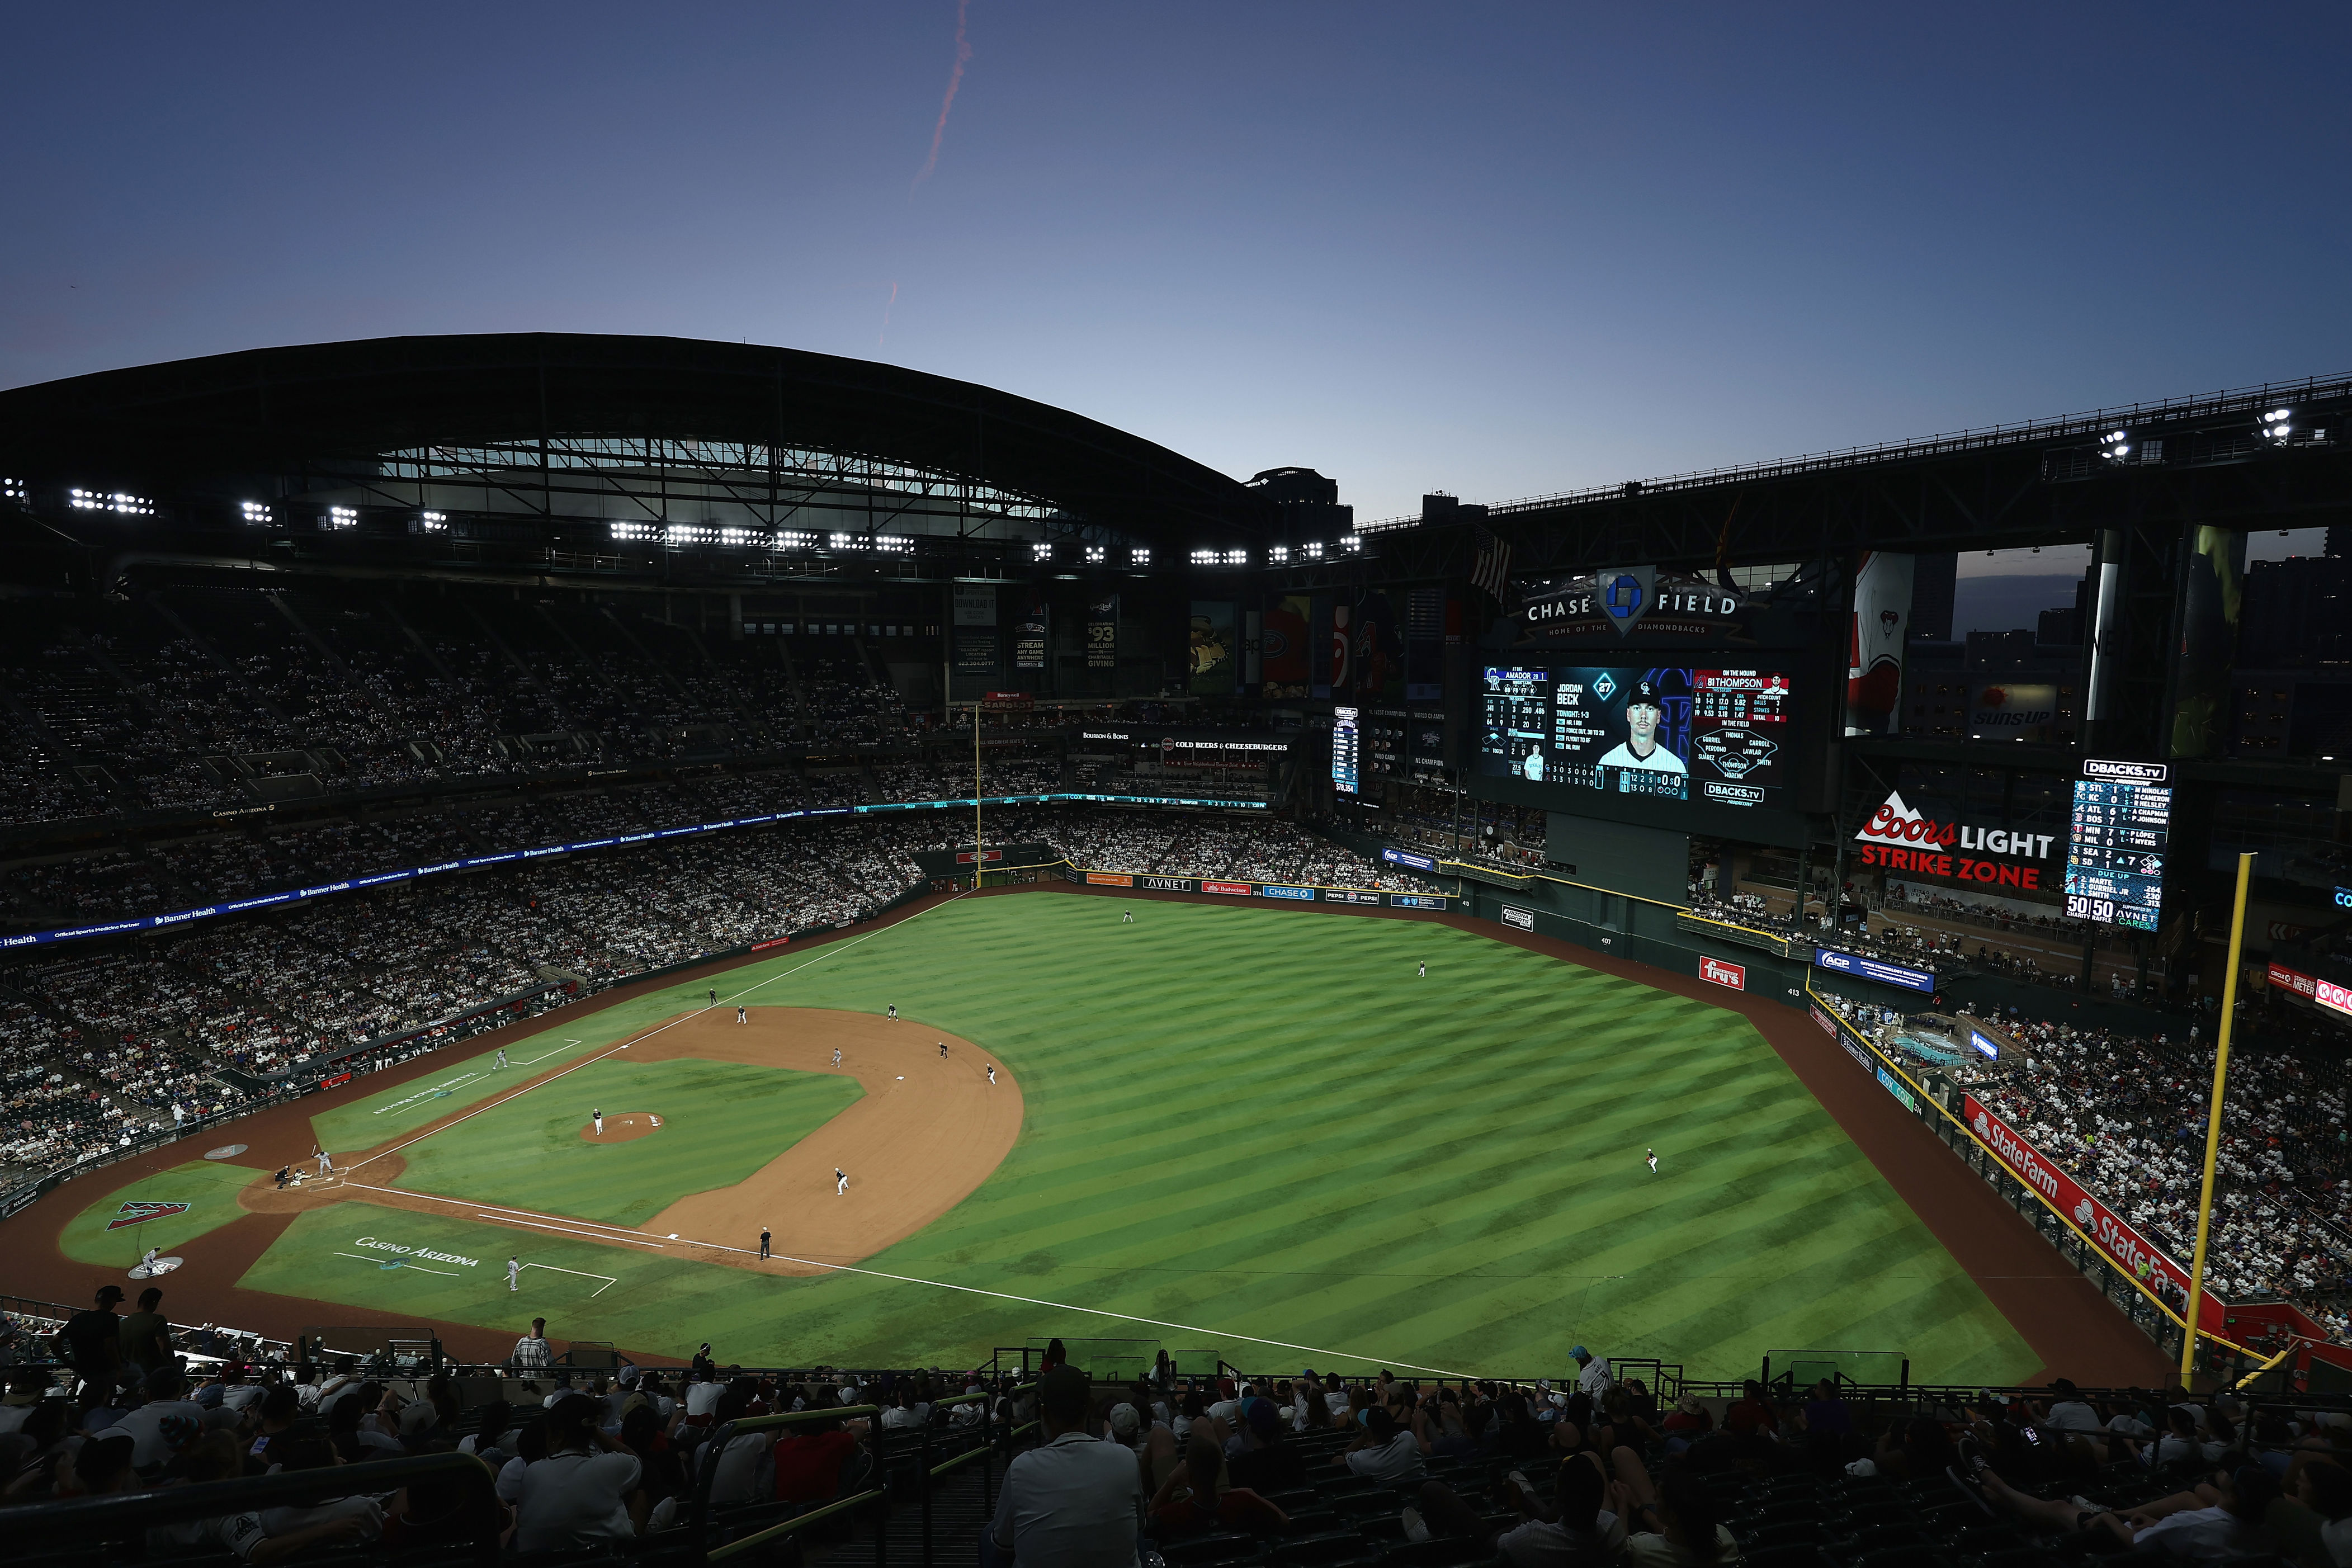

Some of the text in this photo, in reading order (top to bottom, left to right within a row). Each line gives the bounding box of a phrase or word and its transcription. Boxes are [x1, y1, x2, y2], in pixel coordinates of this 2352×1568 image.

[955, 599, 994, 608] DOWNLOAD IT
[1099, 602, 1112, 611] Back
[1528, 594, 1735, 621] CHASE FIELD
[1088, 626, 1114, 641] $93
[1638, 624, 1705, 633] DIAMONDBACKS
[1557, 683, 1583, 693] JORDAN
[1599, 682, 1611, 692] 27
[1707, 678, 1763, 688] 81 THOMPSON
[1557, 693, 1579, 705] BECK
[2089, 763, 2160, 777] DBACKS.TV
[1336, 783, 1353, 792] $78,354
[1708, 785, 1759, 799] DBACKS.TV
[2139, 801, 2166, 809] HELSLEY
[2138, 809, 2169, 818] CHAPMAN
[2086, 815, 2115, 825] BOS 7
[2137, 816, 2166, 825] JOHNSON
[1863, 804, 2056, 859] Coors LIGHT
[2085, 826, 2101, 835] MIN
[2136, 830, 2156, 839] LÓPEZ
[2084, 835, 2099, 844] MIL
[530, 846, 564, 856] Banner Health
[2083, 848, 2136, 866] SEA 2 7
[443, 862, 459, 871] Health
[1861, 844, 2040, 890] STRIKE ZONE
[1148, 879, 1186, 890] AVNET
[2089, 877, 2113, 886] MARTE
[308, 882, 350, 895] Banner Health
[1269, 888, 1298, 897] CHASE
[2089, 884, 2117, 894] GURRIEL
[2087, 890, 2109, 899] SMITH
[164, 908, 215, 923] Banner Health
[1505, 910, 1528, 919] ARIZONA
[1508, 915, 1529, 924] SPORTS
[2066, 911, 2091, 919] CHARITY
[2116, 910, 2156, 923] AVNET
[2118, 918, 2151, 929] CARES
[4, 935, 36, 946] Health
[1826, 956, 1850, 966] ACP
[1704, 961, 1740, 985] fry's
[1875, 964, 1902, 974] TECHNOLOGY
[1903, 970, 1928, 980] SOLUTIONS
[2271, 970, 2285, 979] CIRCLE
[2294, 975, 2307, 984] STRIKE
[2293, 981, 2315, 995] METER
[1846, 1041, 1870, 1068] Banner Health
[1881, 1073, 1909, 1106] COX COX
[1914, 1103, 1922, 1116] 374
[13, 1191, 37, 1207] KUMHO
[355, 1236, 480, 1267] CASINO ARIZONA
